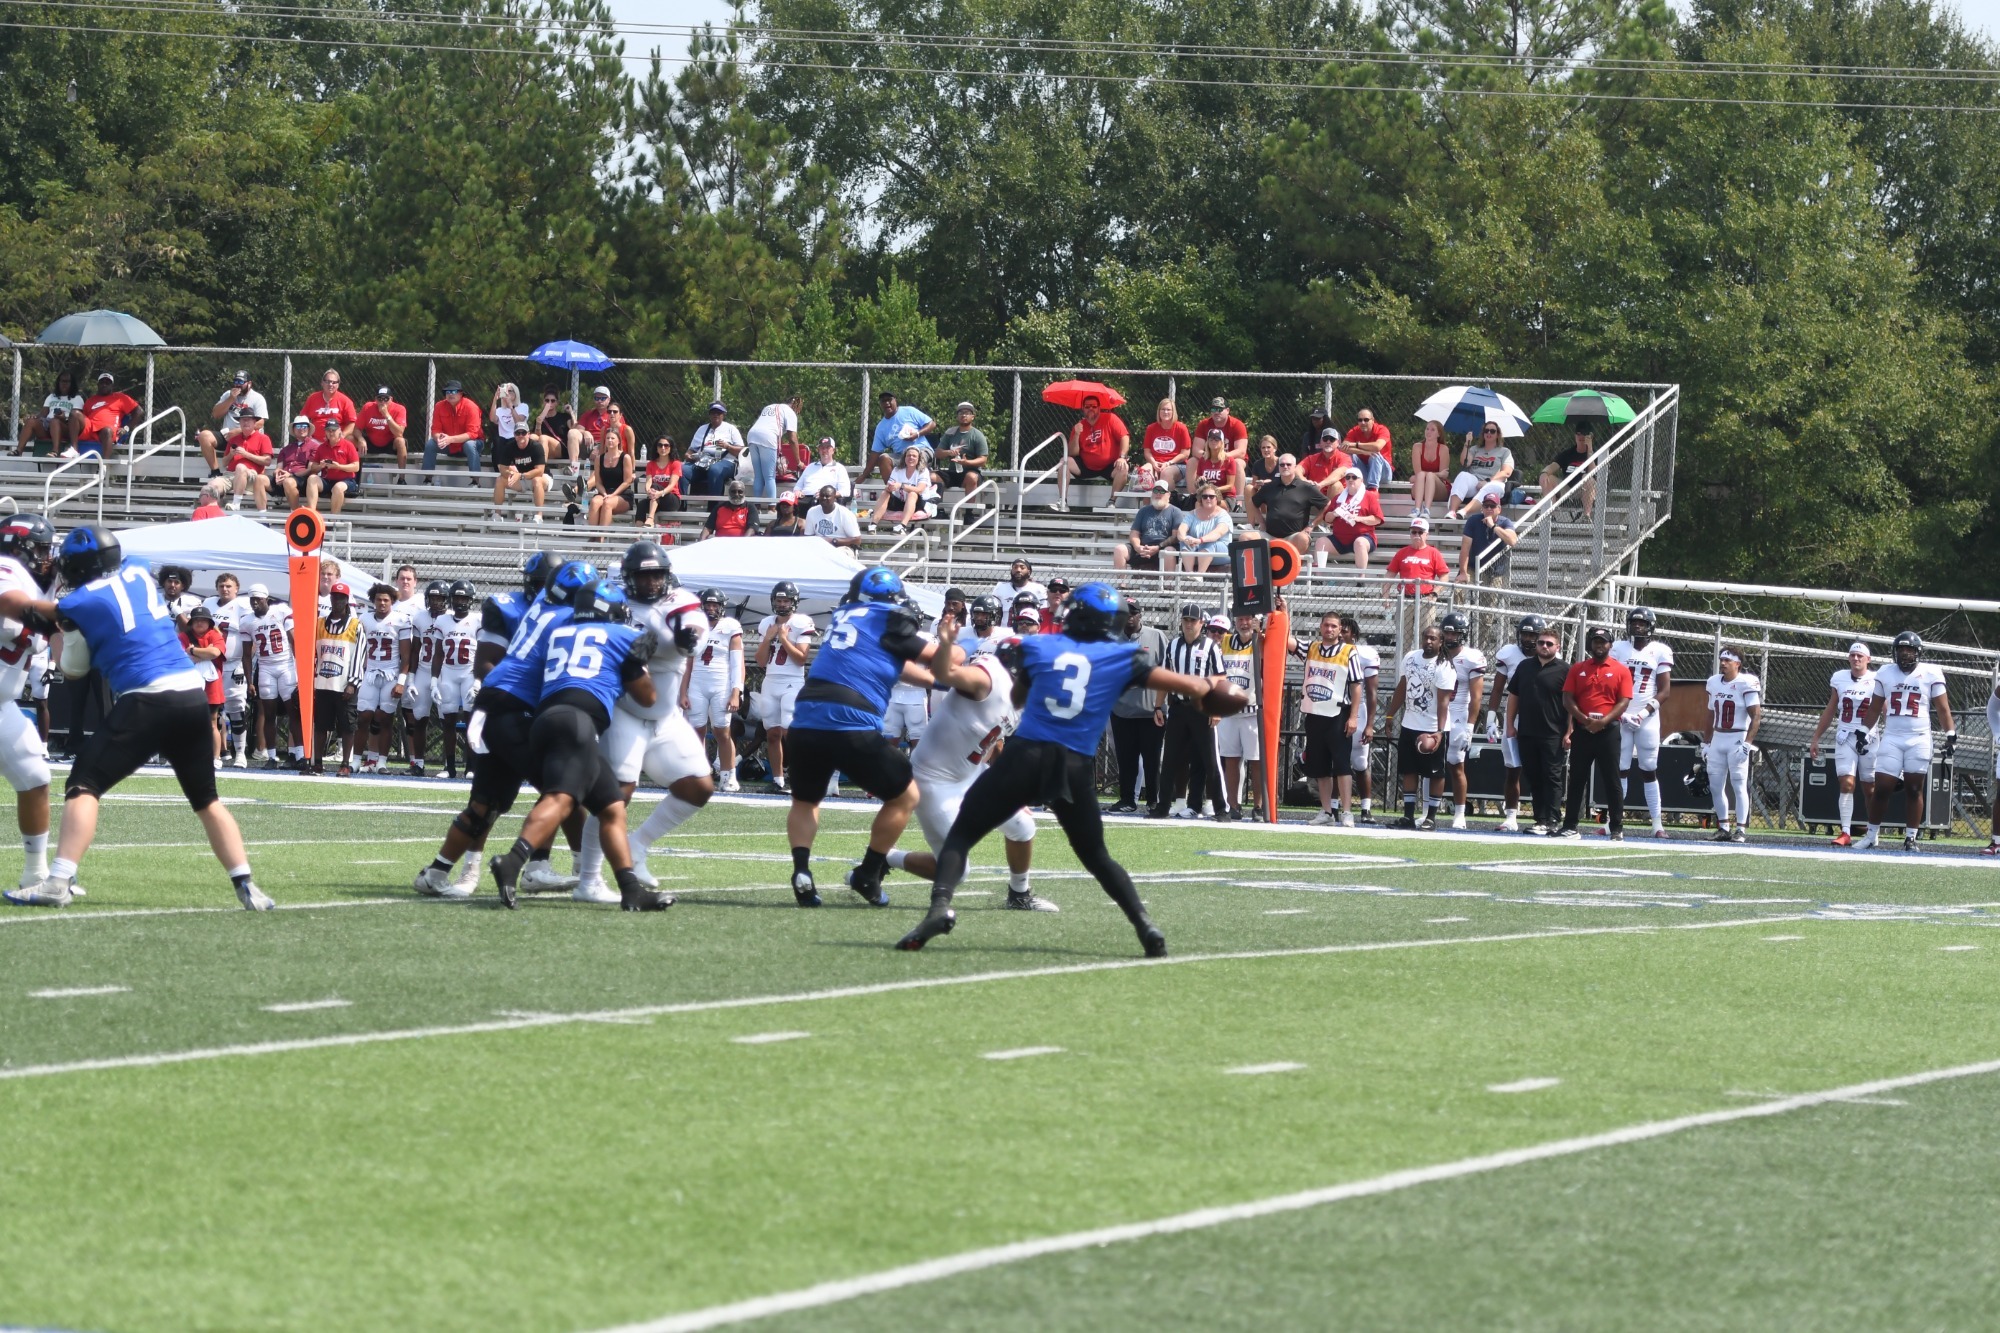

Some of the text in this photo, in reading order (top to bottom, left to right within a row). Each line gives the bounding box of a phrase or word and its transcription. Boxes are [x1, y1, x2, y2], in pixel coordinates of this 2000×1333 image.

[1242, 547, 1258, 587] 1
[85, 565, 170, 634] 72
[254, 629, 284, 657] 20
[506, 603, 557, 661] 61
[367, 637, 393, 661] 25
[422, 636, 433, 662] 3
[444, 638, 471, 665] 26
[544, 626, 608, 682] 56
[1044, 651, 1093, 720] 3
[1308, 666, 1336, 682] NAIA
[1892, 682, 1920, 691] Fire
[1713, 699, 1736, 729] 10
[1889, 691, 1922, 718] 55
